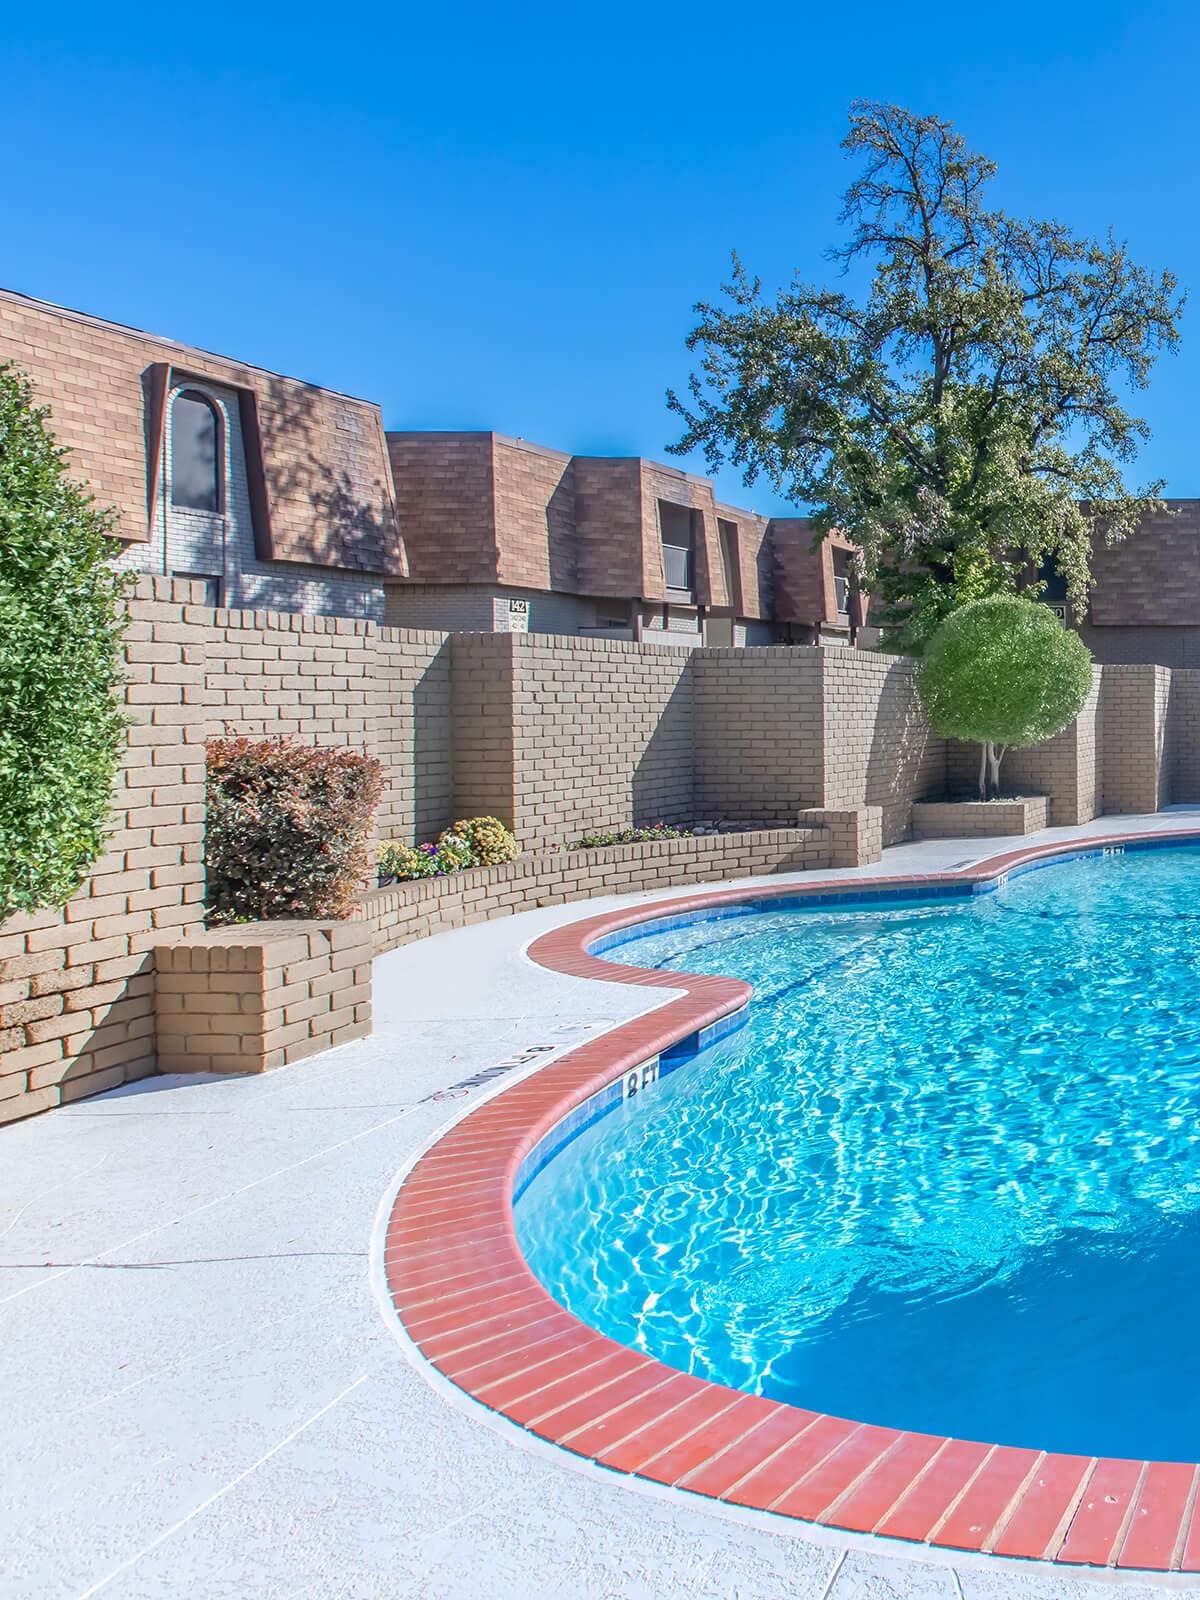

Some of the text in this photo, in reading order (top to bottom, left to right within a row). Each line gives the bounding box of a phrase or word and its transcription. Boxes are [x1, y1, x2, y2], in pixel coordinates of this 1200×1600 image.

[511, 600, 525, 611] 142
[627, 1060, 658, 1098] 8 FT
